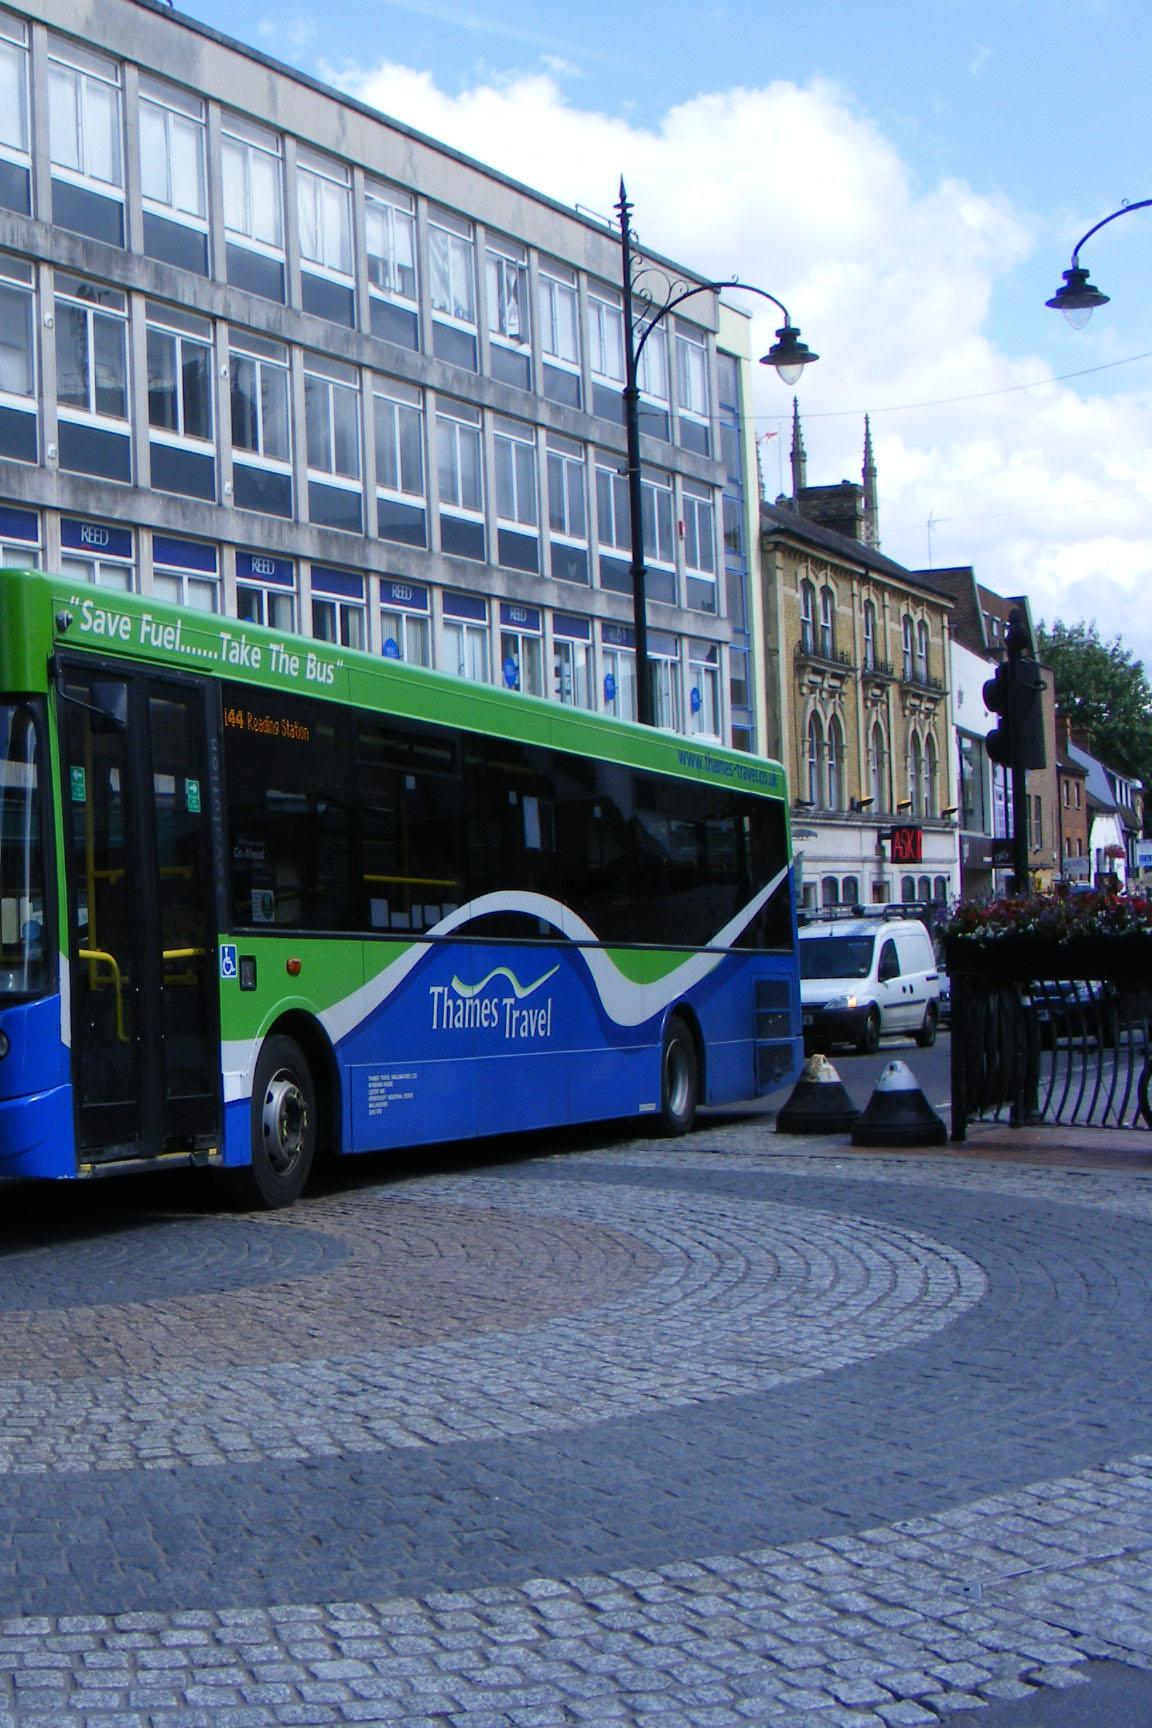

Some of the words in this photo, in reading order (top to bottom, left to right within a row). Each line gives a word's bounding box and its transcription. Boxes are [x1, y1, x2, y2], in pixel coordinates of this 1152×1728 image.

[80, 524, 109, 546] REED
[251, 555, 275, 576] REED
[391, 583, 412, 601] REED
[509, 606, 527, 623] REED
[269, 642, 300, 677] The
[223, 707, 244, 729] 144
[246, 711, 280, 736] Reading
[281, 718, 310, 742] Station
[429, 985, 499, 1030] Thames
[502, 997, 552, 1039] Travel
